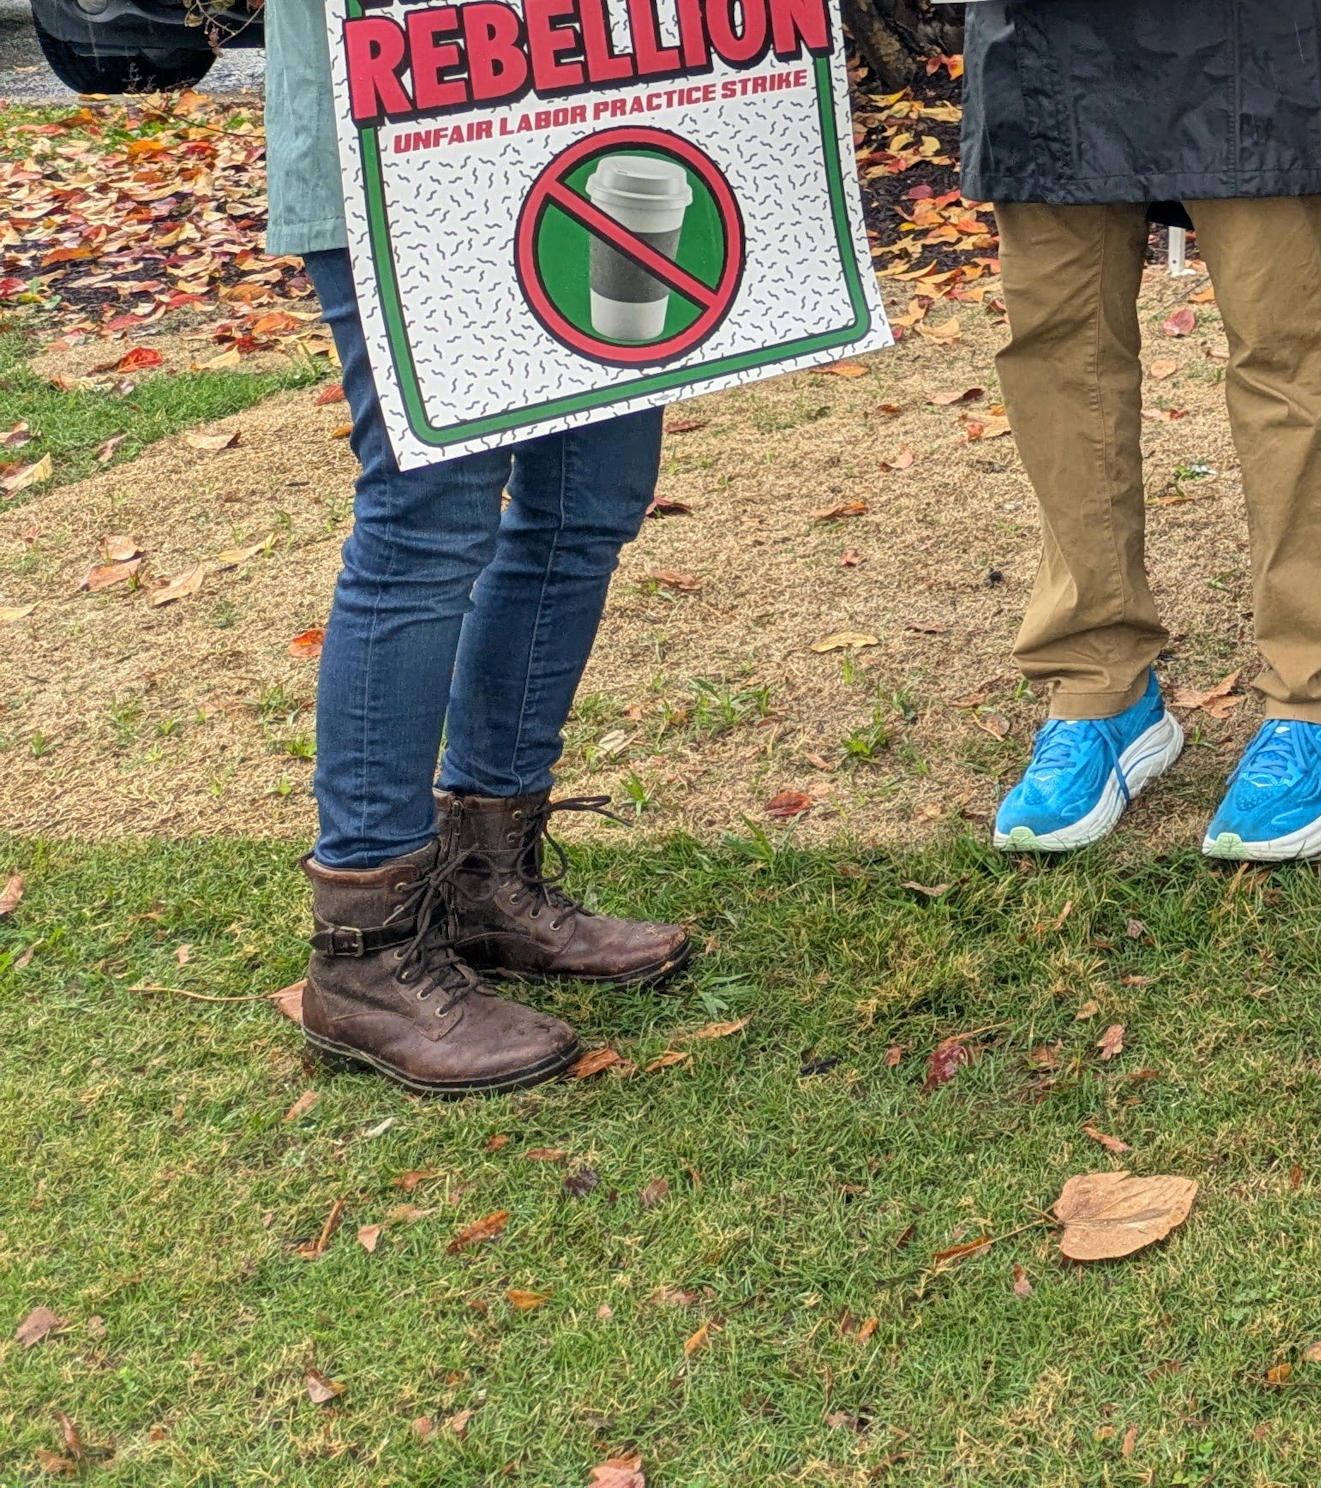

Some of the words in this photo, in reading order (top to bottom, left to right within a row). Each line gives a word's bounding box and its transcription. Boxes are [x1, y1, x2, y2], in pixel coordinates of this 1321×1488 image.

[394, 118, 493, 154] UNFAIR
[500, 98, 597, 137] LABOR
[599, 84, 716, 119] PRACTICE
[721, 69, 808, 102] STRIKE
